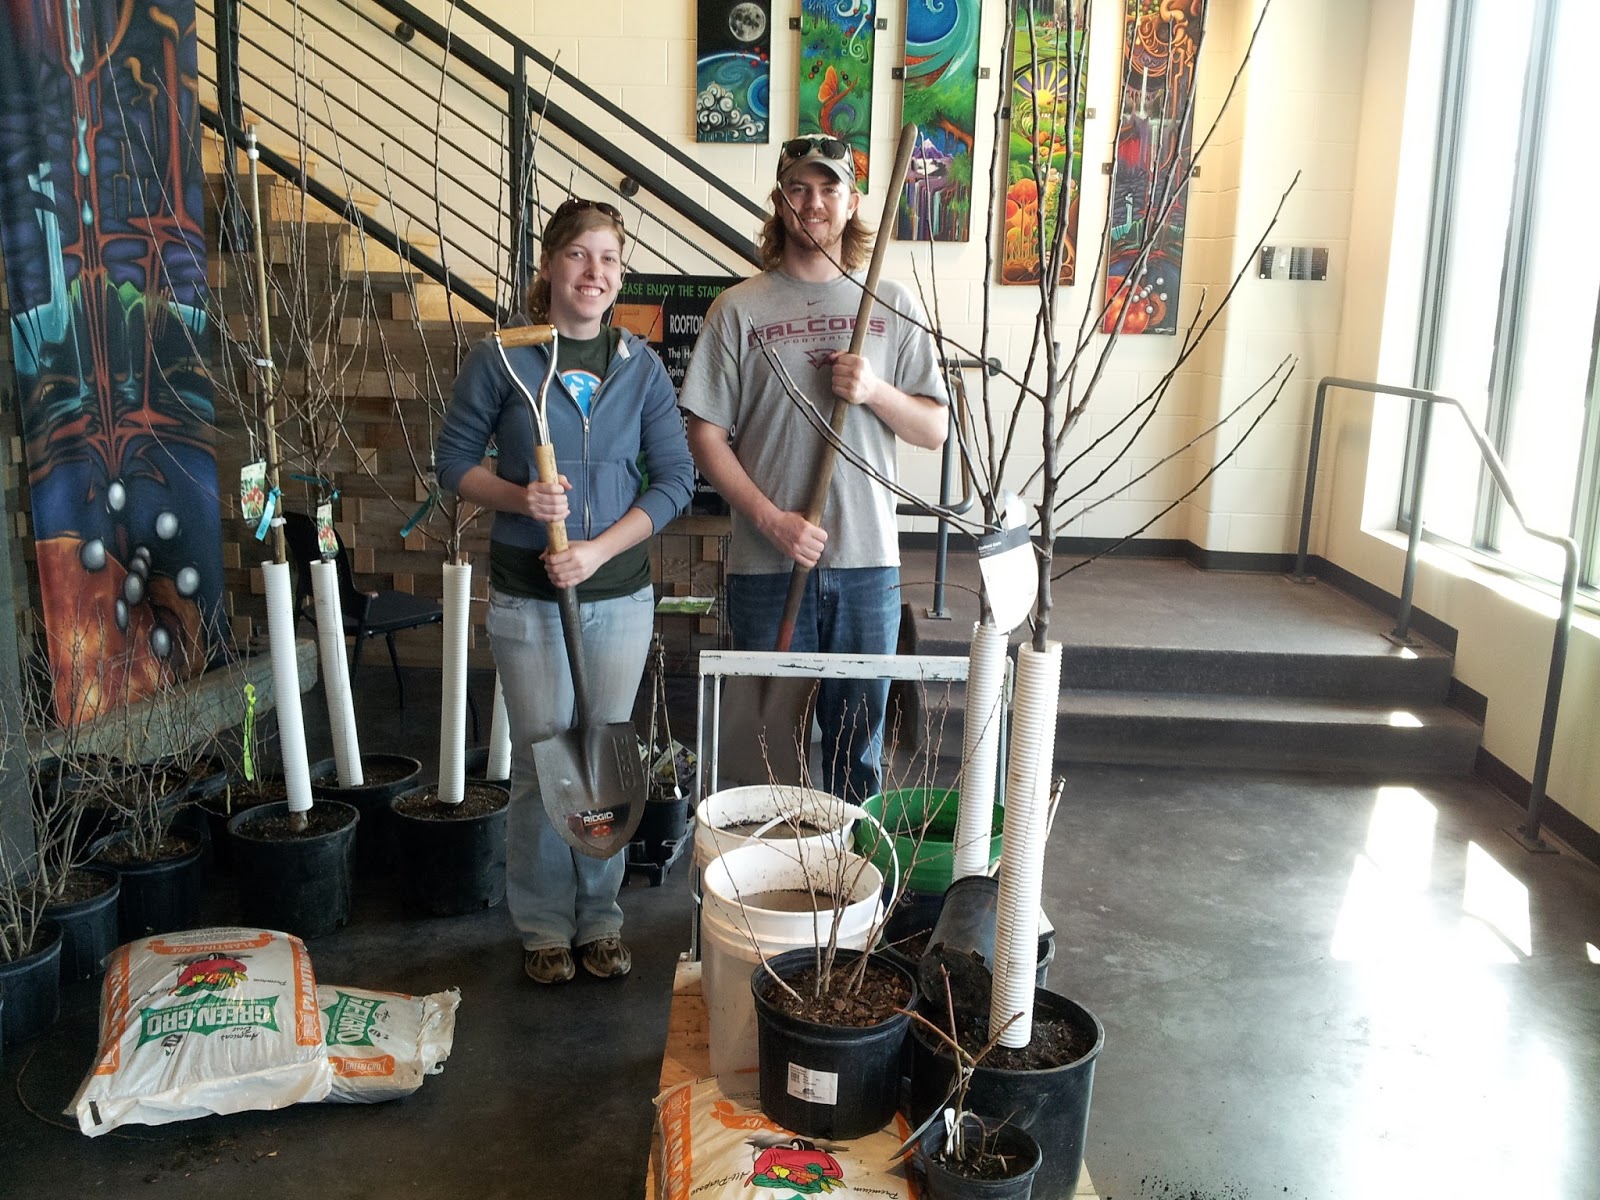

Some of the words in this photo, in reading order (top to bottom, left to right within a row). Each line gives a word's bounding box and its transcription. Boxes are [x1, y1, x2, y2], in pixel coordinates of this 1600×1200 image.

[619, 283, 643, 295] EASE
[646, 284, 677, 296] ENJOY
[679, 285, 694, 297] THE
[667, 347, 681, 359] The
[667, 365, 685, 378] Spire
[583, 811, 614, 824] RIDGID
[147, 1009, 193, 1035] GRO
[197, 1005, 270, 1027] GREEN
[690, 1170, 750, 1197] All-Purpose
[853, 1186, 899, 1200] Premium
